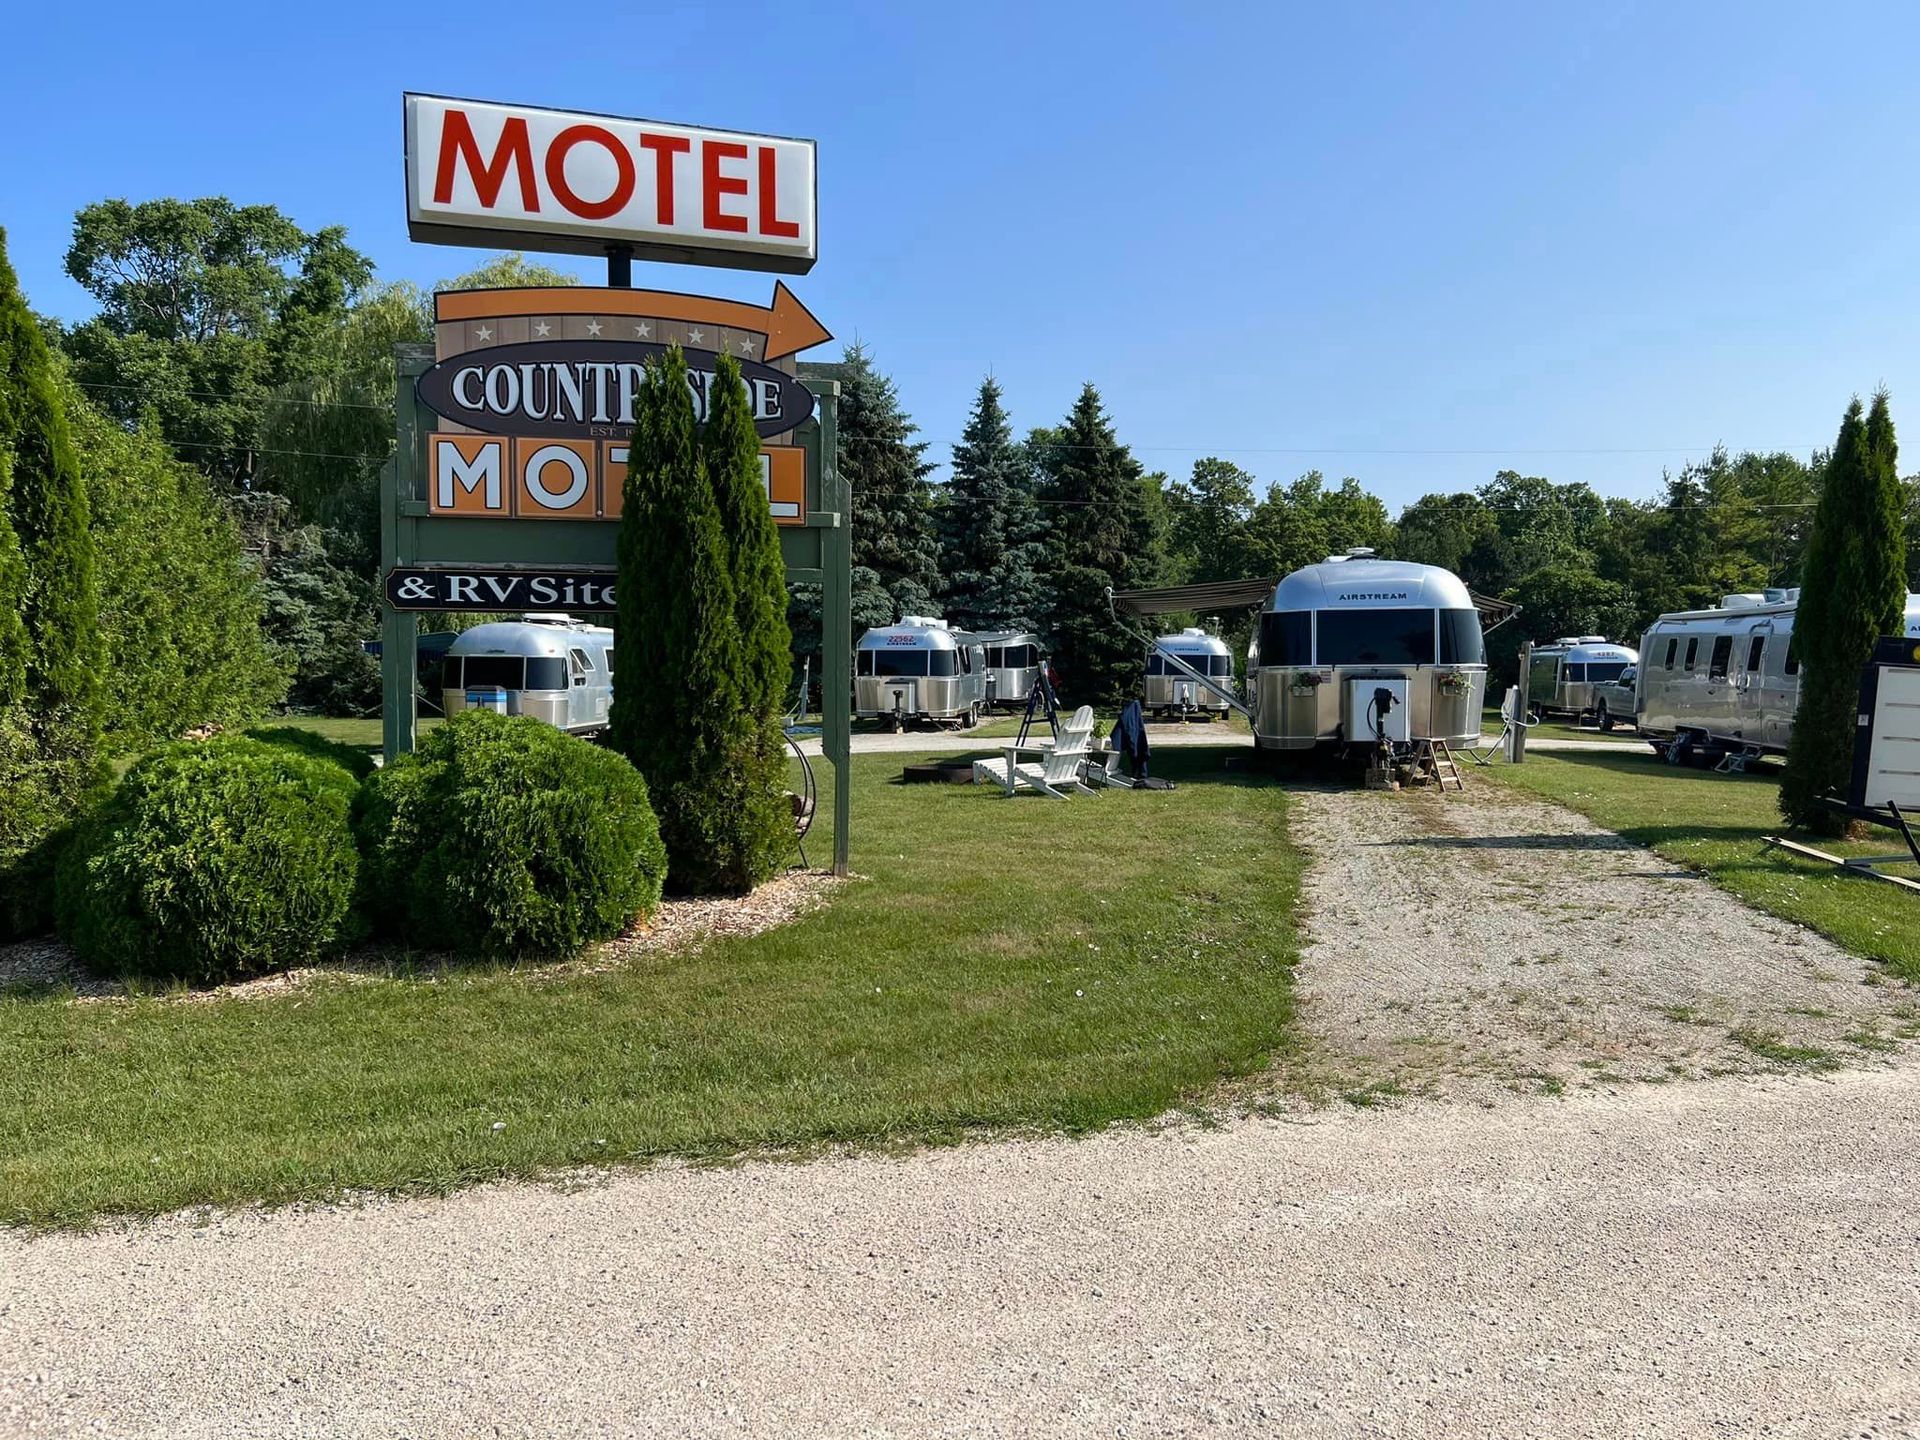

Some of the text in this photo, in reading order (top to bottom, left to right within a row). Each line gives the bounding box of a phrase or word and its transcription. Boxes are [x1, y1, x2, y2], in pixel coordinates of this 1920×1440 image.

[433, 109, 800, 238] MOTEL
[590, 426, 617, 437] EST.
[436, 440, 800, 518] MOL
[397, 576, 435, 599] &
[445, 575, 523, 603] RV
[1339, 592, 1407, 601] AIRSTREAM
